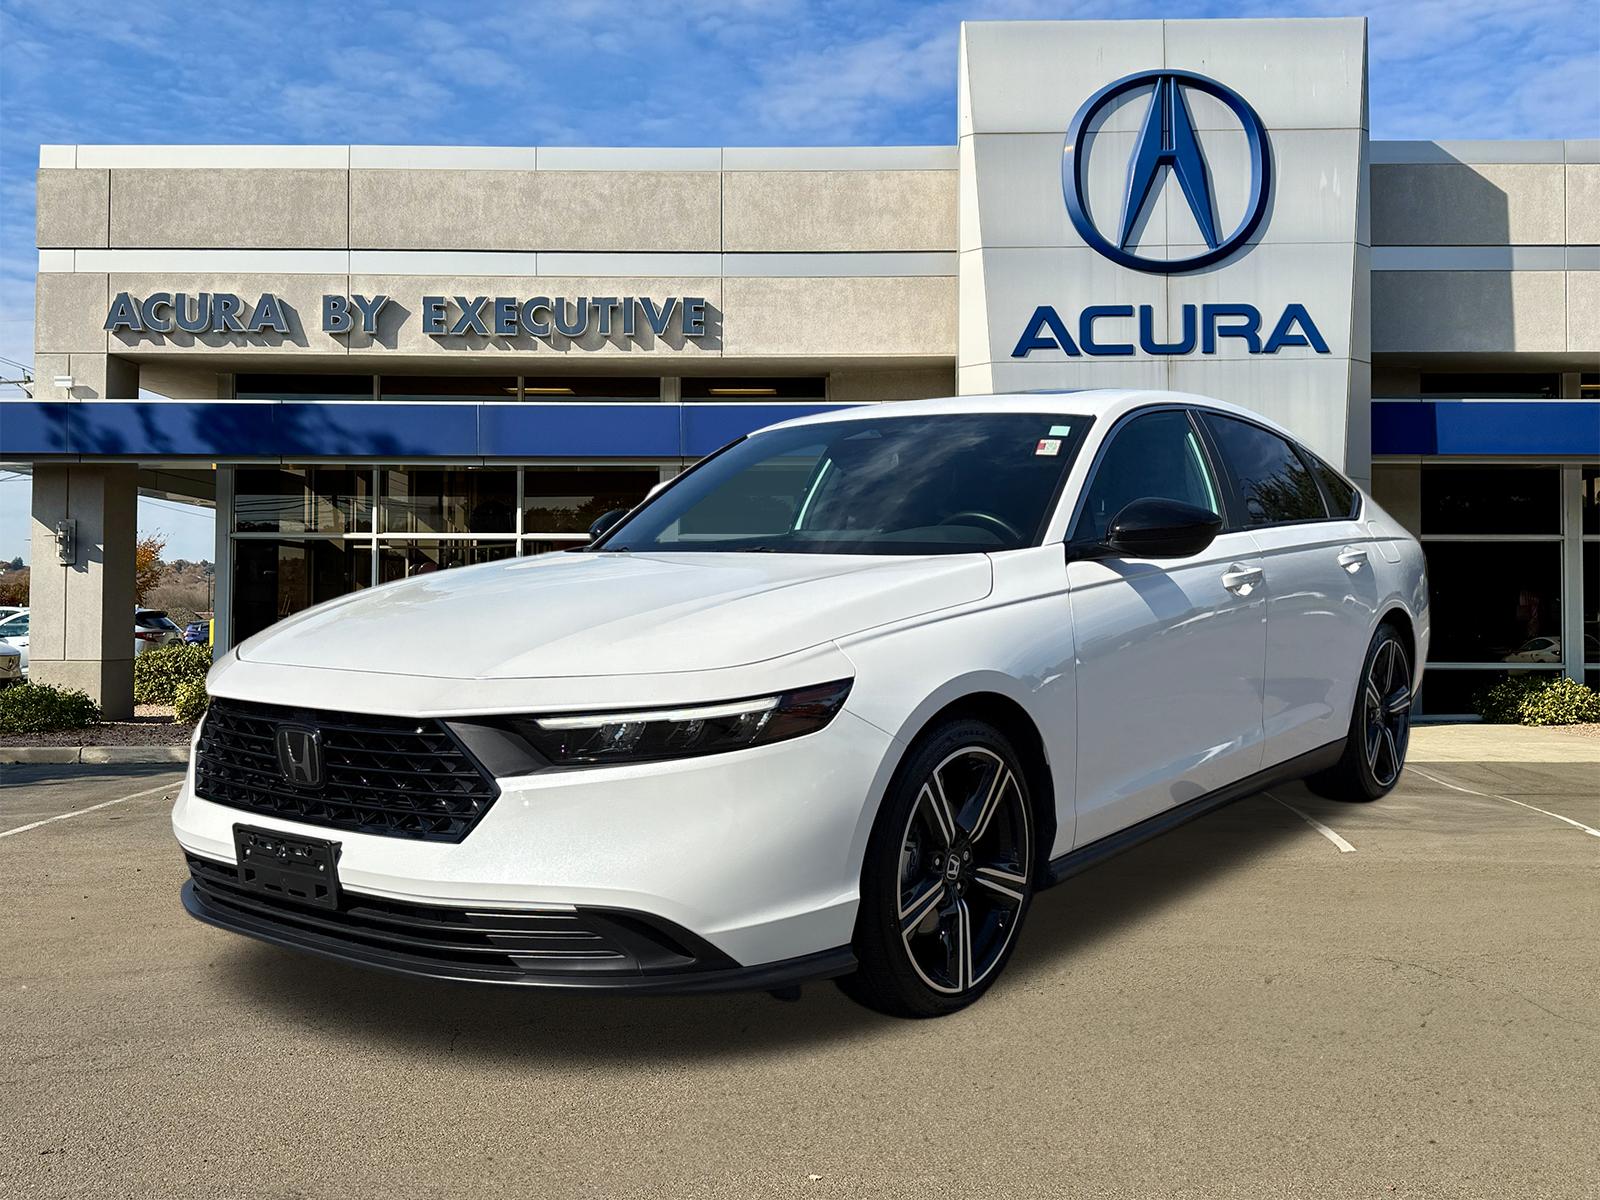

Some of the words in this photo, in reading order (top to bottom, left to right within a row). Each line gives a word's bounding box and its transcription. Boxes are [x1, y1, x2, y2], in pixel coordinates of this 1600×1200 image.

[103, 292, 290, 333] ACURA
[322, 294, 391, 335] BY
[422, 296, 705, 336] EXECUTIVE
[1010, 304, 1331, 357] ACURA
